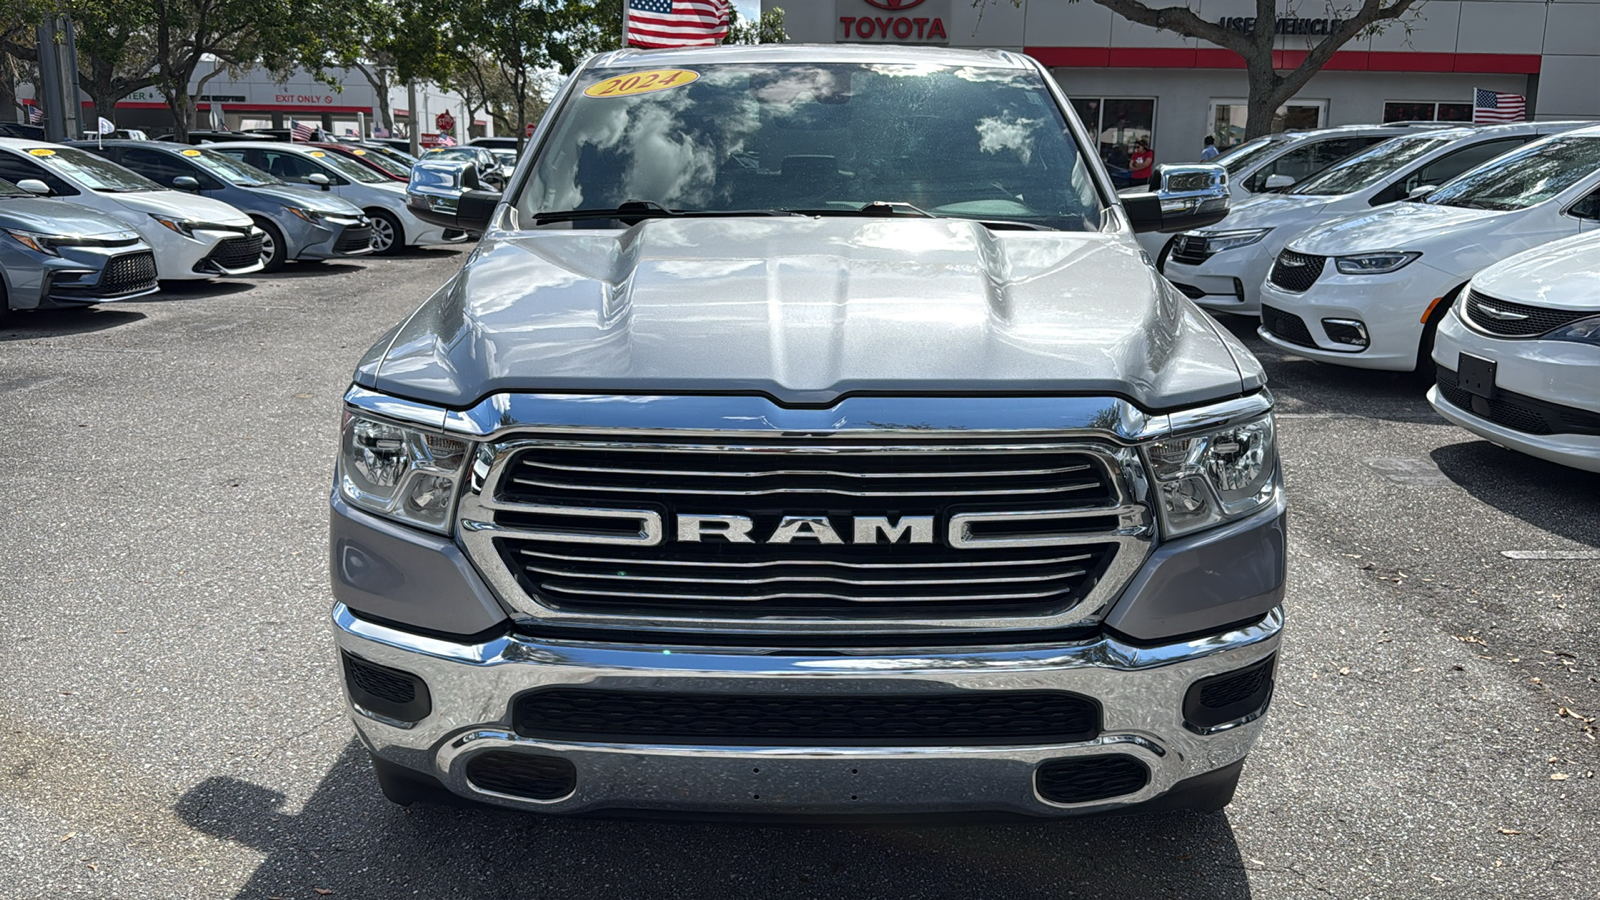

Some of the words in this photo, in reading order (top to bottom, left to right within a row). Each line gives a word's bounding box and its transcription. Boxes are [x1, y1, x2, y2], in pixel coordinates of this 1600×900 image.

[840, 16, 947, 38] TOYOTA
[1219, 16, 1257, 34] USE
[1275, 17, 1352, 35] VEHICLE
[598, 70, 683, 95] 2024
[275, 94, 295, 103] EXIT
[297, 95, 321, 103] ONLY
[676, 513, 934, 544] RAM
